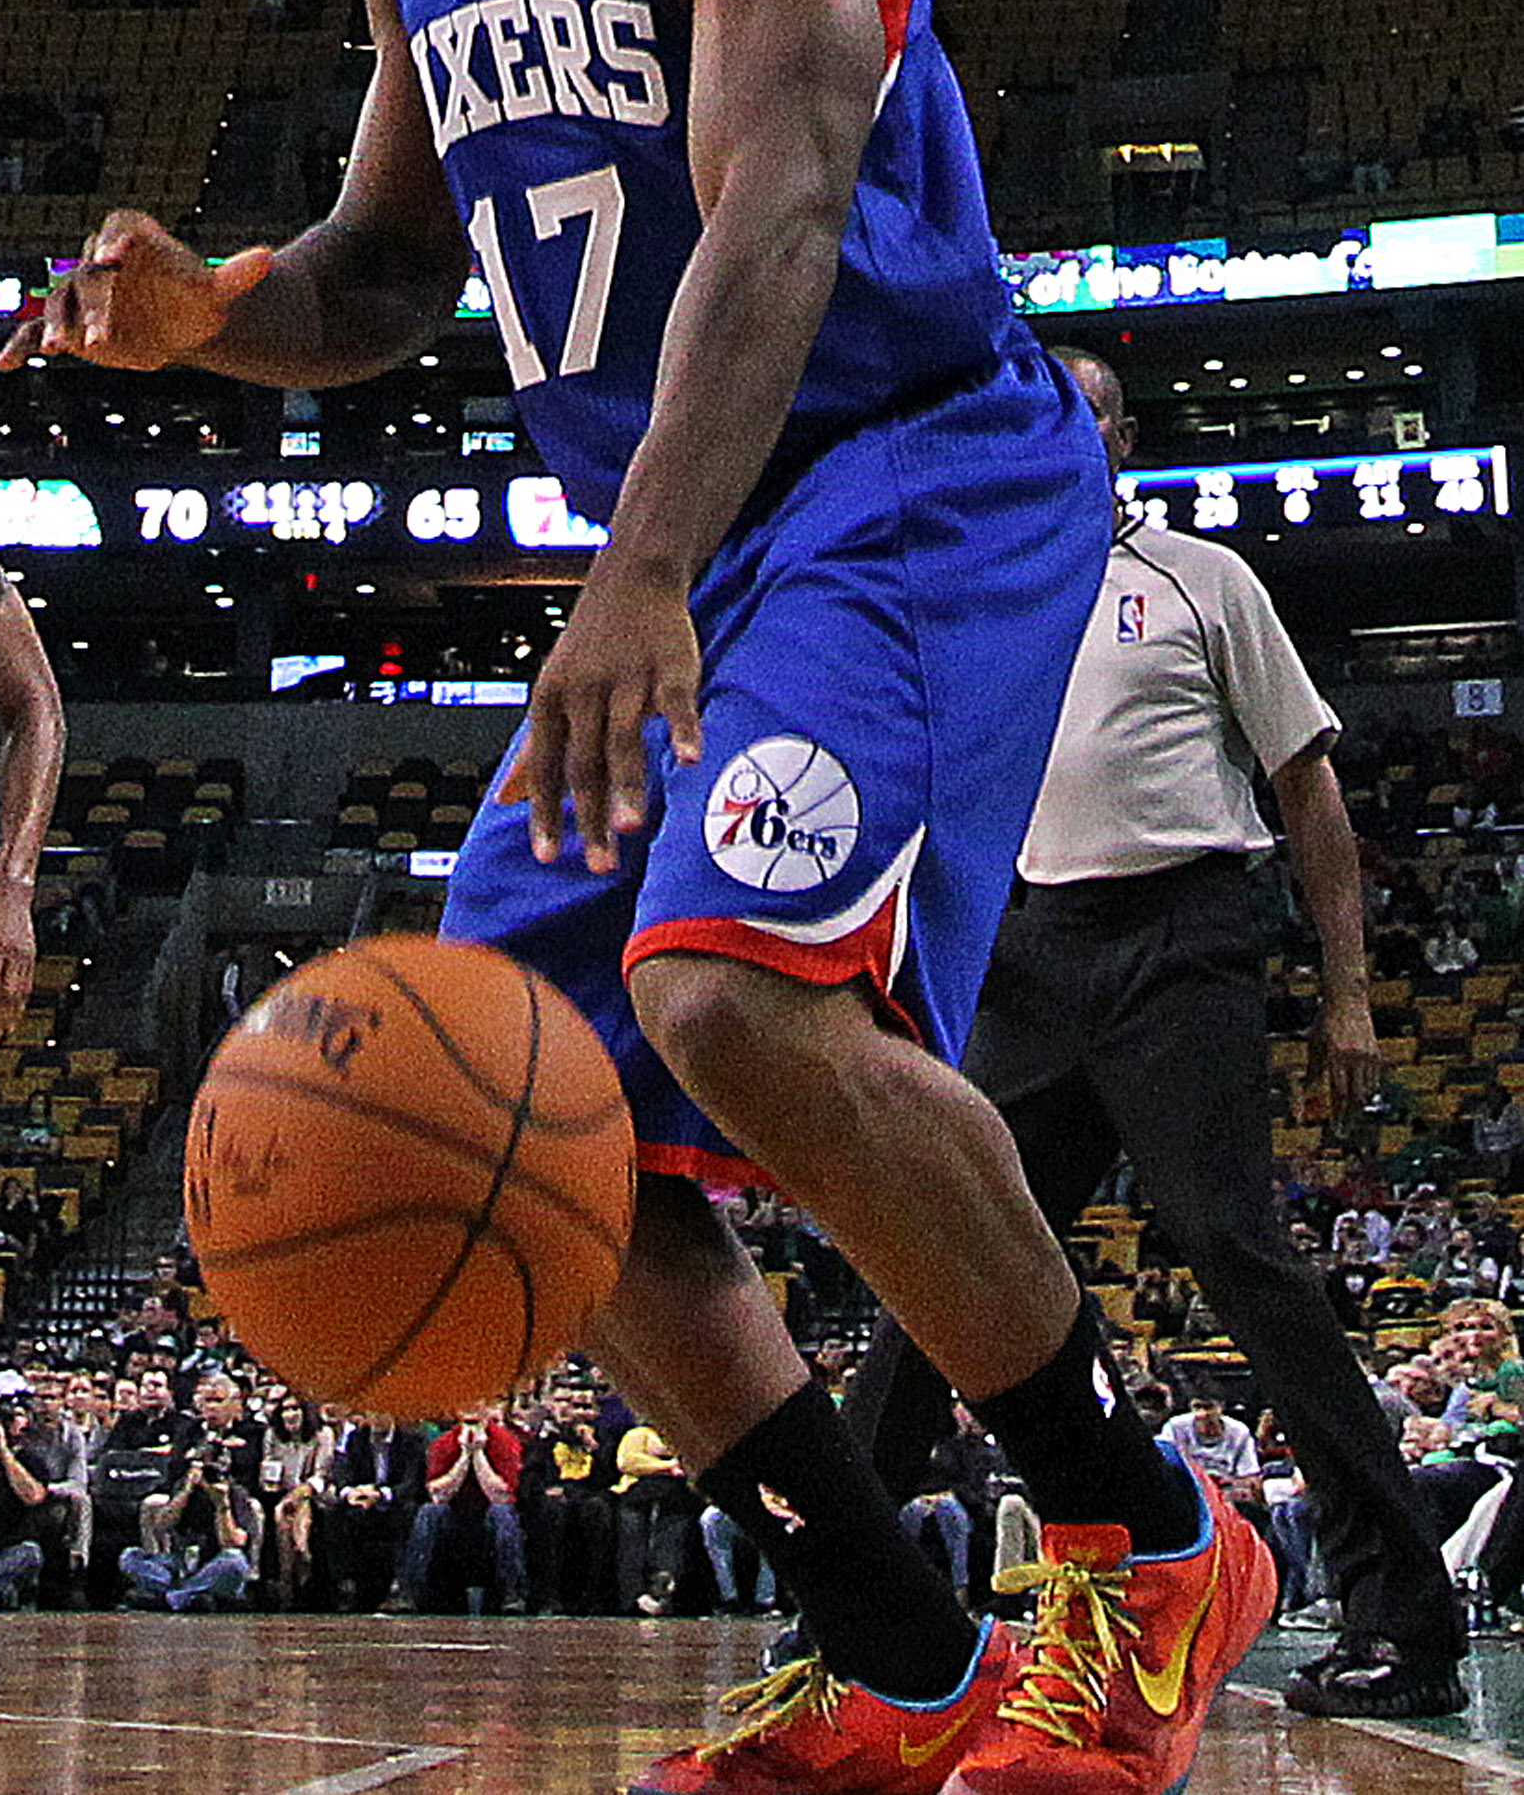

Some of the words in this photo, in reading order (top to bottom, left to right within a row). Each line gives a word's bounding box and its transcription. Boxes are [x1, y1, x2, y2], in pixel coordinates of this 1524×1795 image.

[468, 165, 625, 391] 17
[1028, 259, 1082, 306] of
[1085, 258, 1162, 300] the
[135, 488, 209, 540] 70
[407, 488, 482, 541] 65
[717, 796, 837, 860] 76ers
